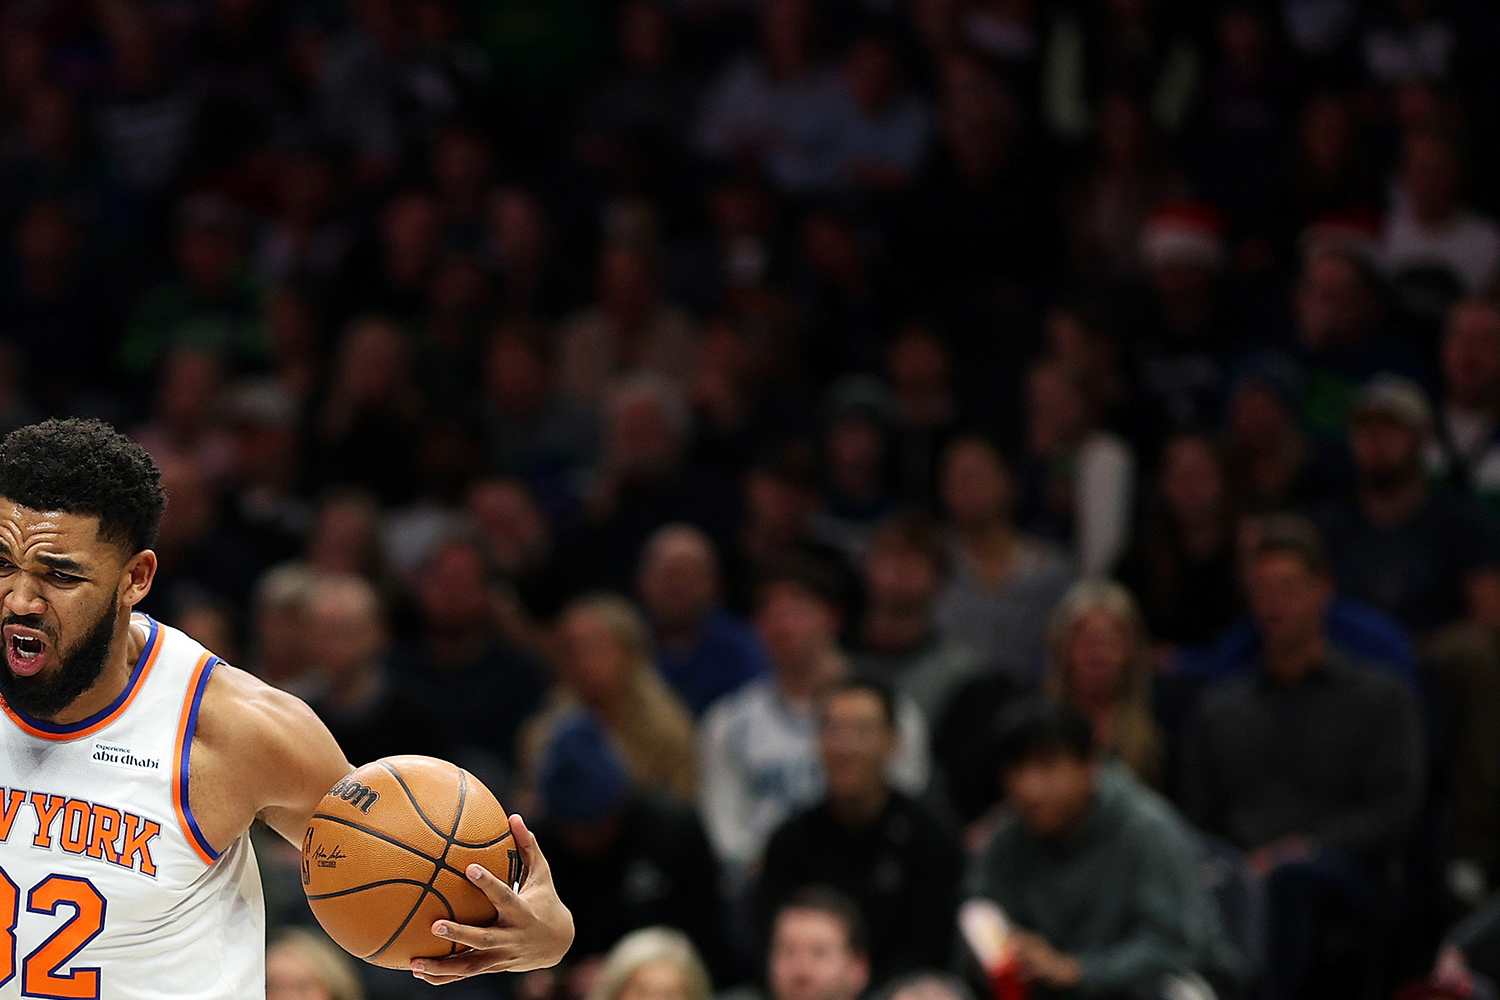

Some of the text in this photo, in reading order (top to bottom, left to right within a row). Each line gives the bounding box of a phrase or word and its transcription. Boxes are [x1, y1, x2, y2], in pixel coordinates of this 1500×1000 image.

[95, 743, 132, 754] experience
[92, 751, 160, 769] abu dhabi
[30, 790, 164, 880] YORK
